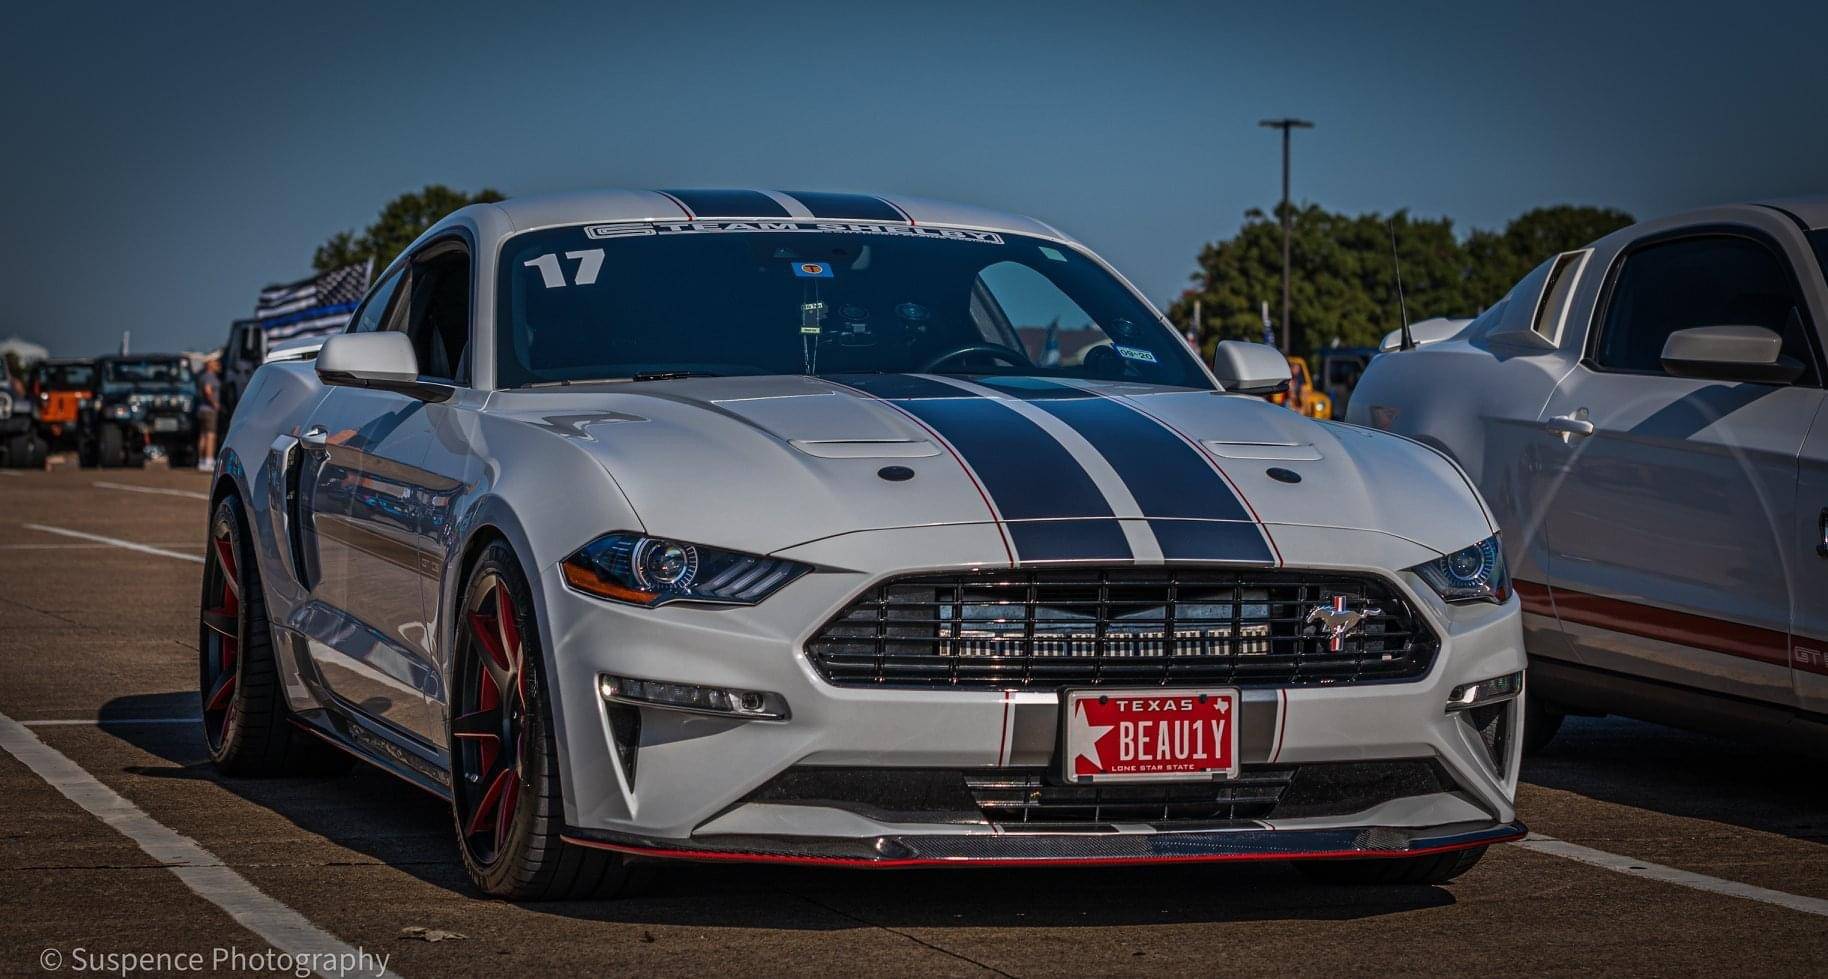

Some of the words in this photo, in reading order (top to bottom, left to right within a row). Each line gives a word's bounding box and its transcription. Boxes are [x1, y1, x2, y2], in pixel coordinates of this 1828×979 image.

[655, 221, 800, 233] TEAM
[816, 223, 994, 242] SHELBY
[523, 248, 606, 289] 17
[1116, 700, 1193, 712] TEXAS
[1119, 719, 1226, 761] BEAU1Y
[1166, 763, 1195, 771] STATE
